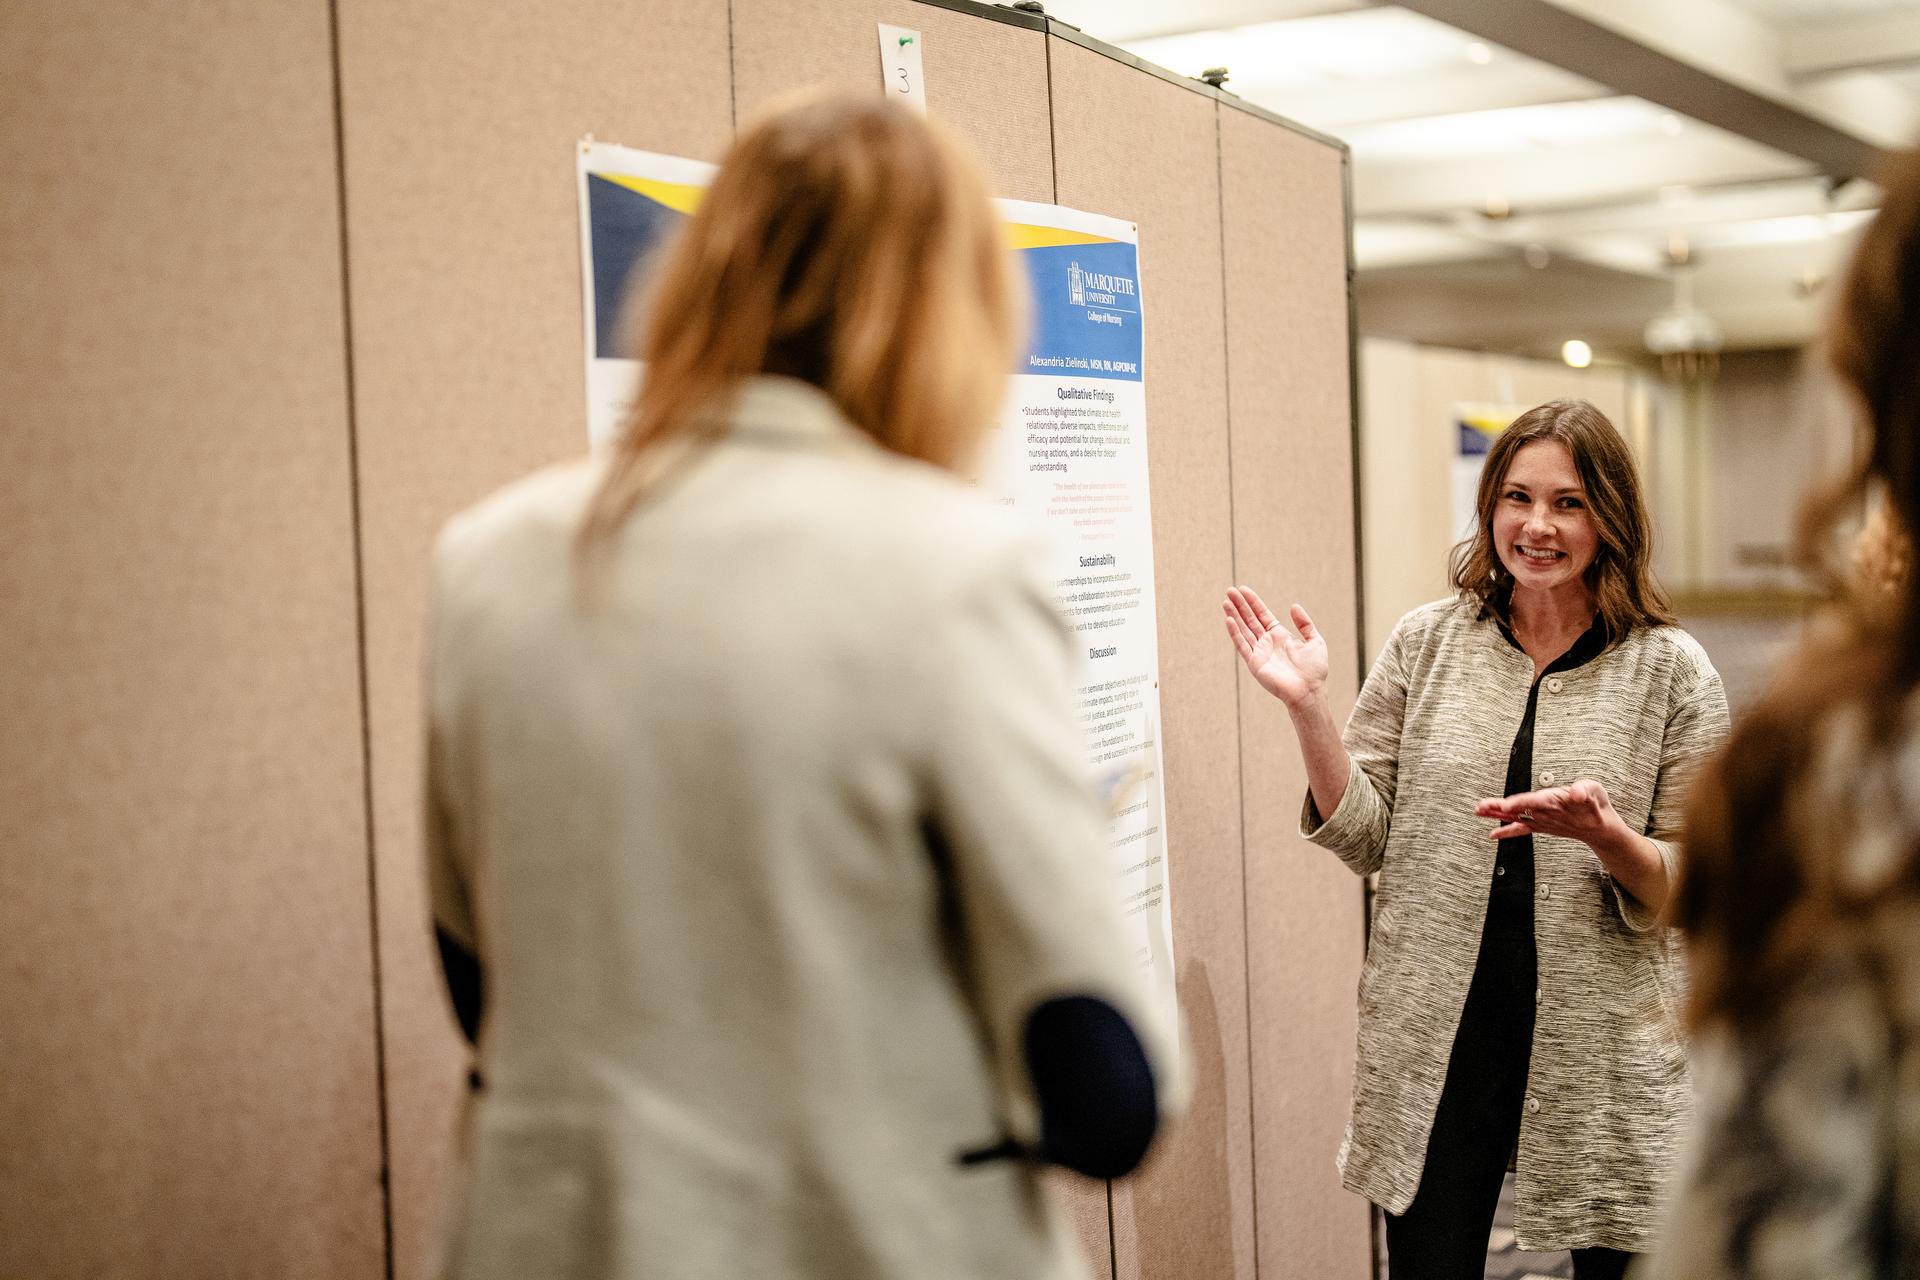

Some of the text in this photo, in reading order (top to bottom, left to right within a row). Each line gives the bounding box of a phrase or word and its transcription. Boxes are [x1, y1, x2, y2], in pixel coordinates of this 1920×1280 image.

[897, 67, 910, 94] 3
[1084, 272, 1134, 295] MARQUETTE
[1086, 292, 1116, 305] UNIVERSITY
[1088, 311, 1102, 324] College
[1107, 314, 1122, 326] Nursing
[1030, 355, 1064, 368] Alexandria
[1065, 357, 1090, 370] Zielinski,
[1090, 360, 1103, 371] MSN,
[1058, 388, 1114, 403] Qualitative Findings
[1025, 406, 1049, 416] Students
[1050, 407, 1077, 418] highlighted
[1078, 408, 1086, 417] the
[1026, 420, 1059, 431] relationship,
[1060, 421, 1077, 430] diverse
[1028, 434, 1048, 444] efficacy
[1049, 435, 1058, 443] and
[1060, 435, 1081, 445] potential
[1029, 449, 1048, 459] nursing
[1070, 449, 1079, 457] and
[1030, 462, 1067, 472] understanding
[1080, 554, 1116, 567] Sustainability
[1078, 592, 1105, 602] collaboration
[1090, 645, 1117, 659] Discussion
